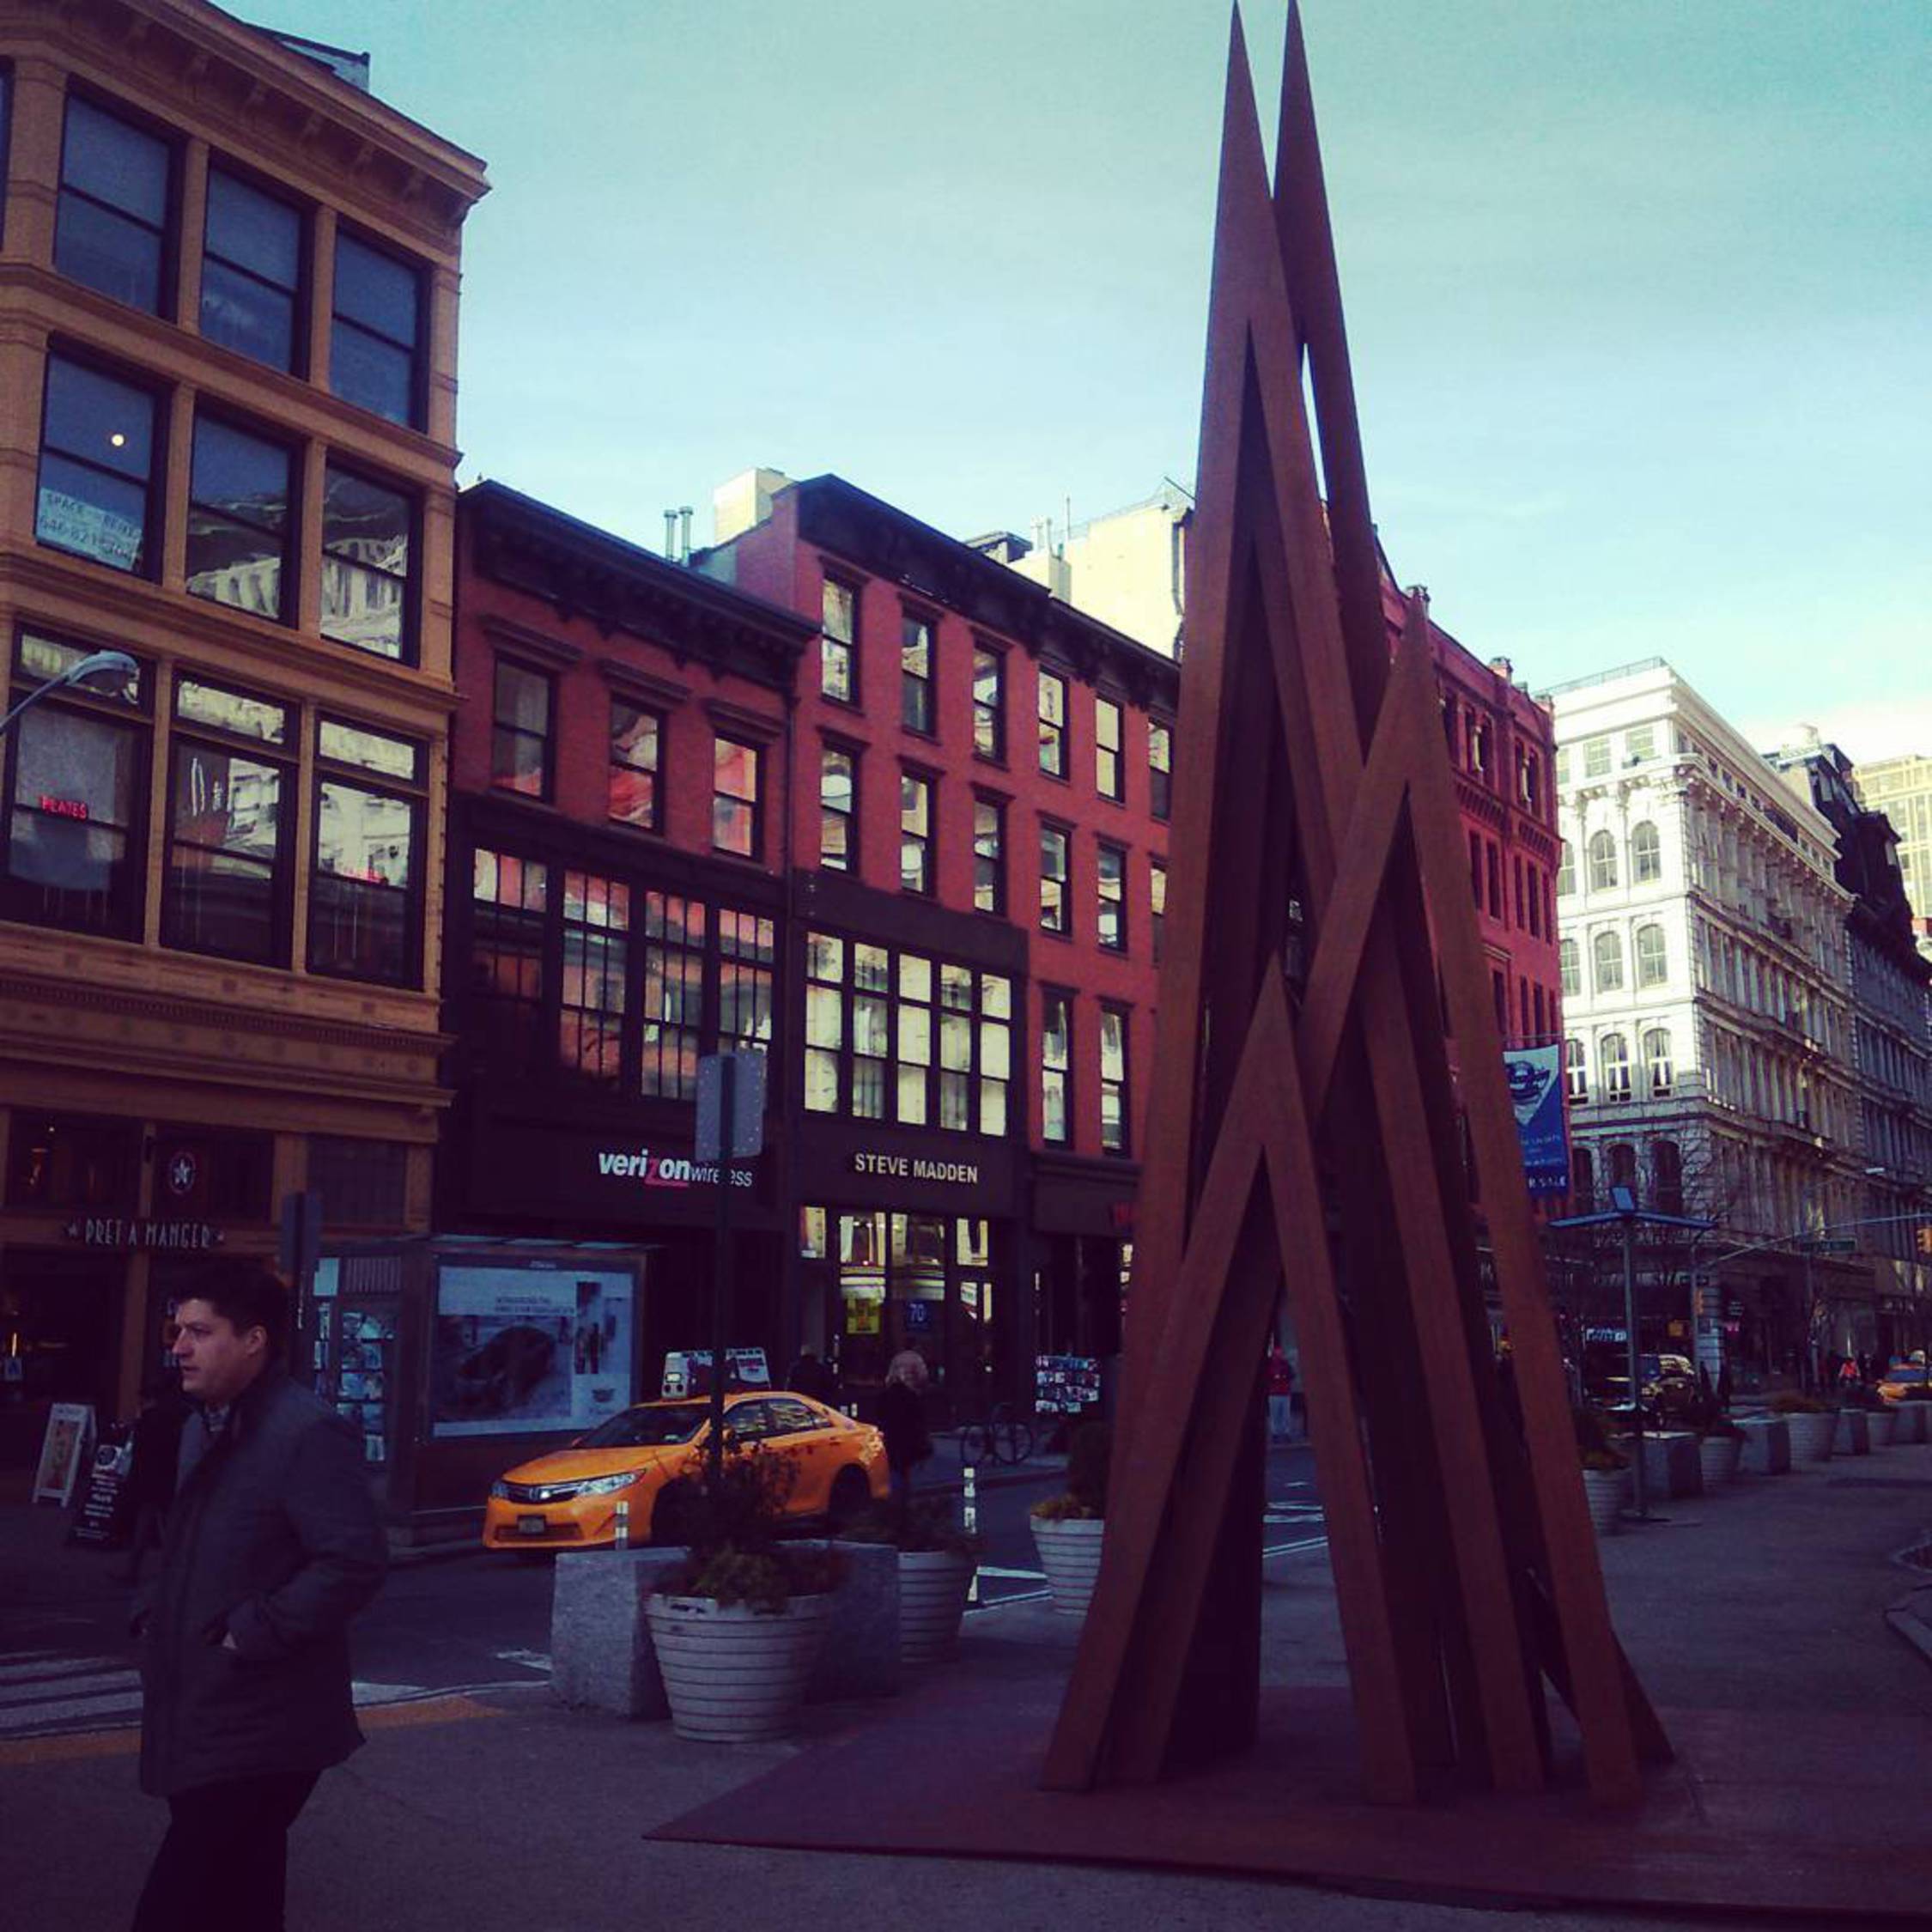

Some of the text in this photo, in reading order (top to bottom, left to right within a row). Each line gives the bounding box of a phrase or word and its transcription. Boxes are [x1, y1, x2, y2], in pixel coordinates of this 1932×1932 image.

[598, 1148, 753, 1188] verizon wireess
[854, 1152, 978, 1184] STEVE MADDEN
[85, 1218, 211, 1249] PRET A MANGER
